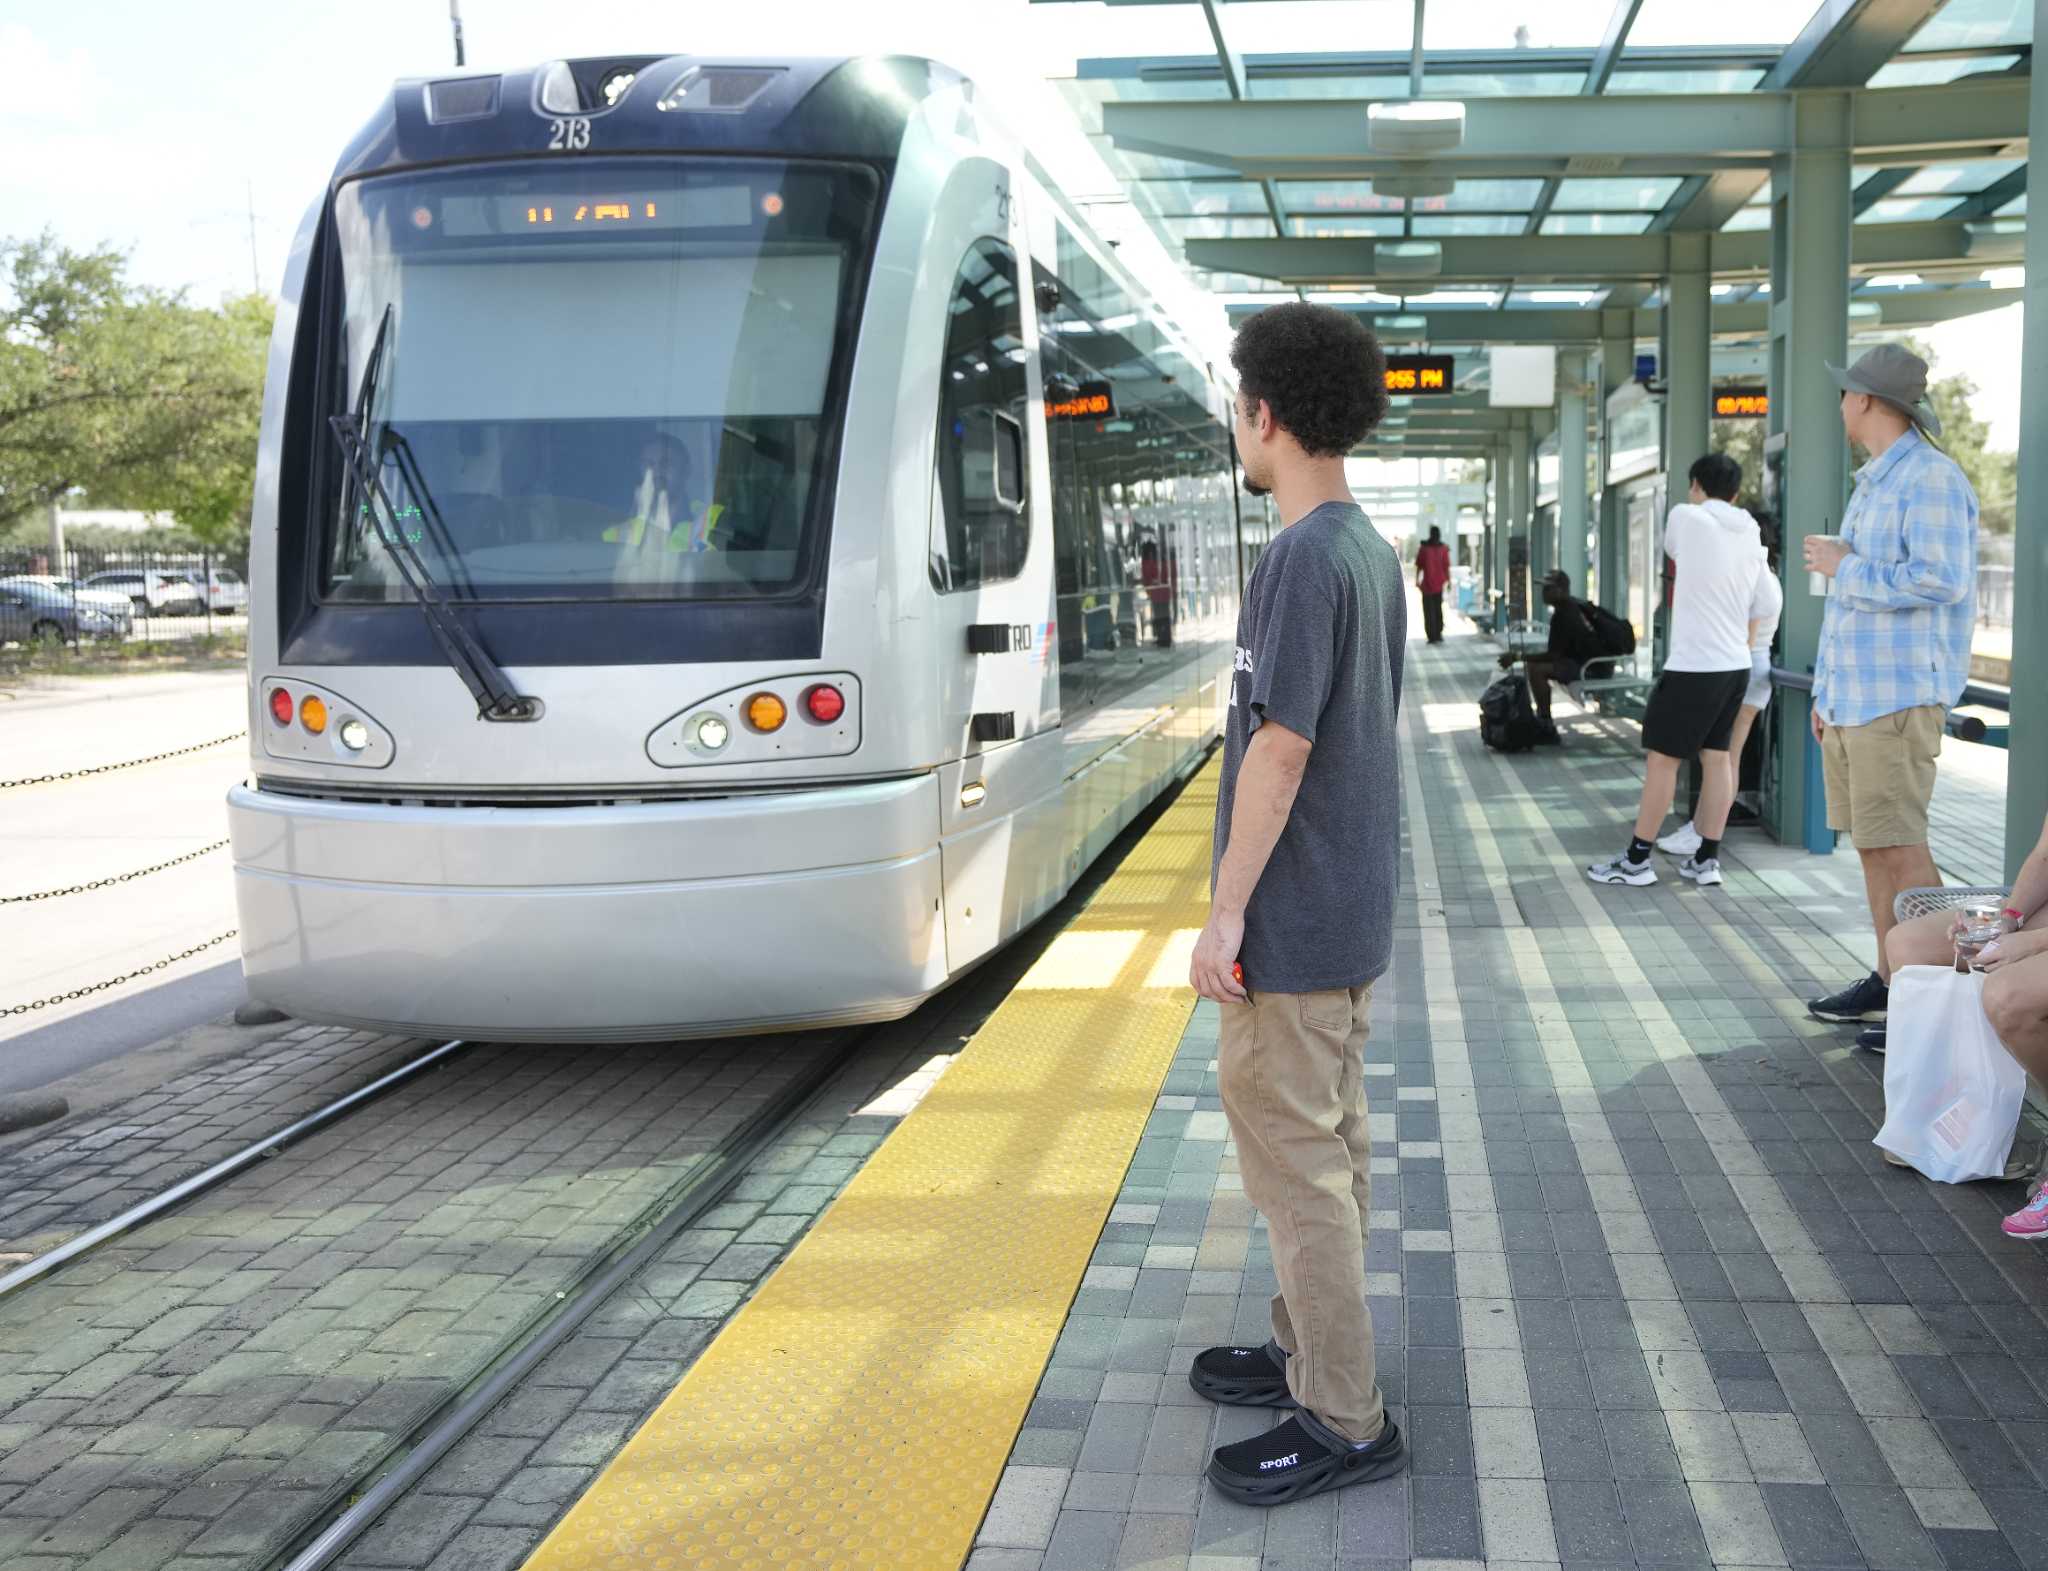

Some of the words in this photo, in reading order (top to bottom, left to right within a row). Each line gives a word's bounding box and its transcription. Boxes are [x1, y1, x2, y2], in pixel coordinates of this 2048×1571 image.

[549, 119, 591, 149] 213
[1420, 369, 1443, 388] PM
[1259, 1452, 1299, 1470] SPORT
